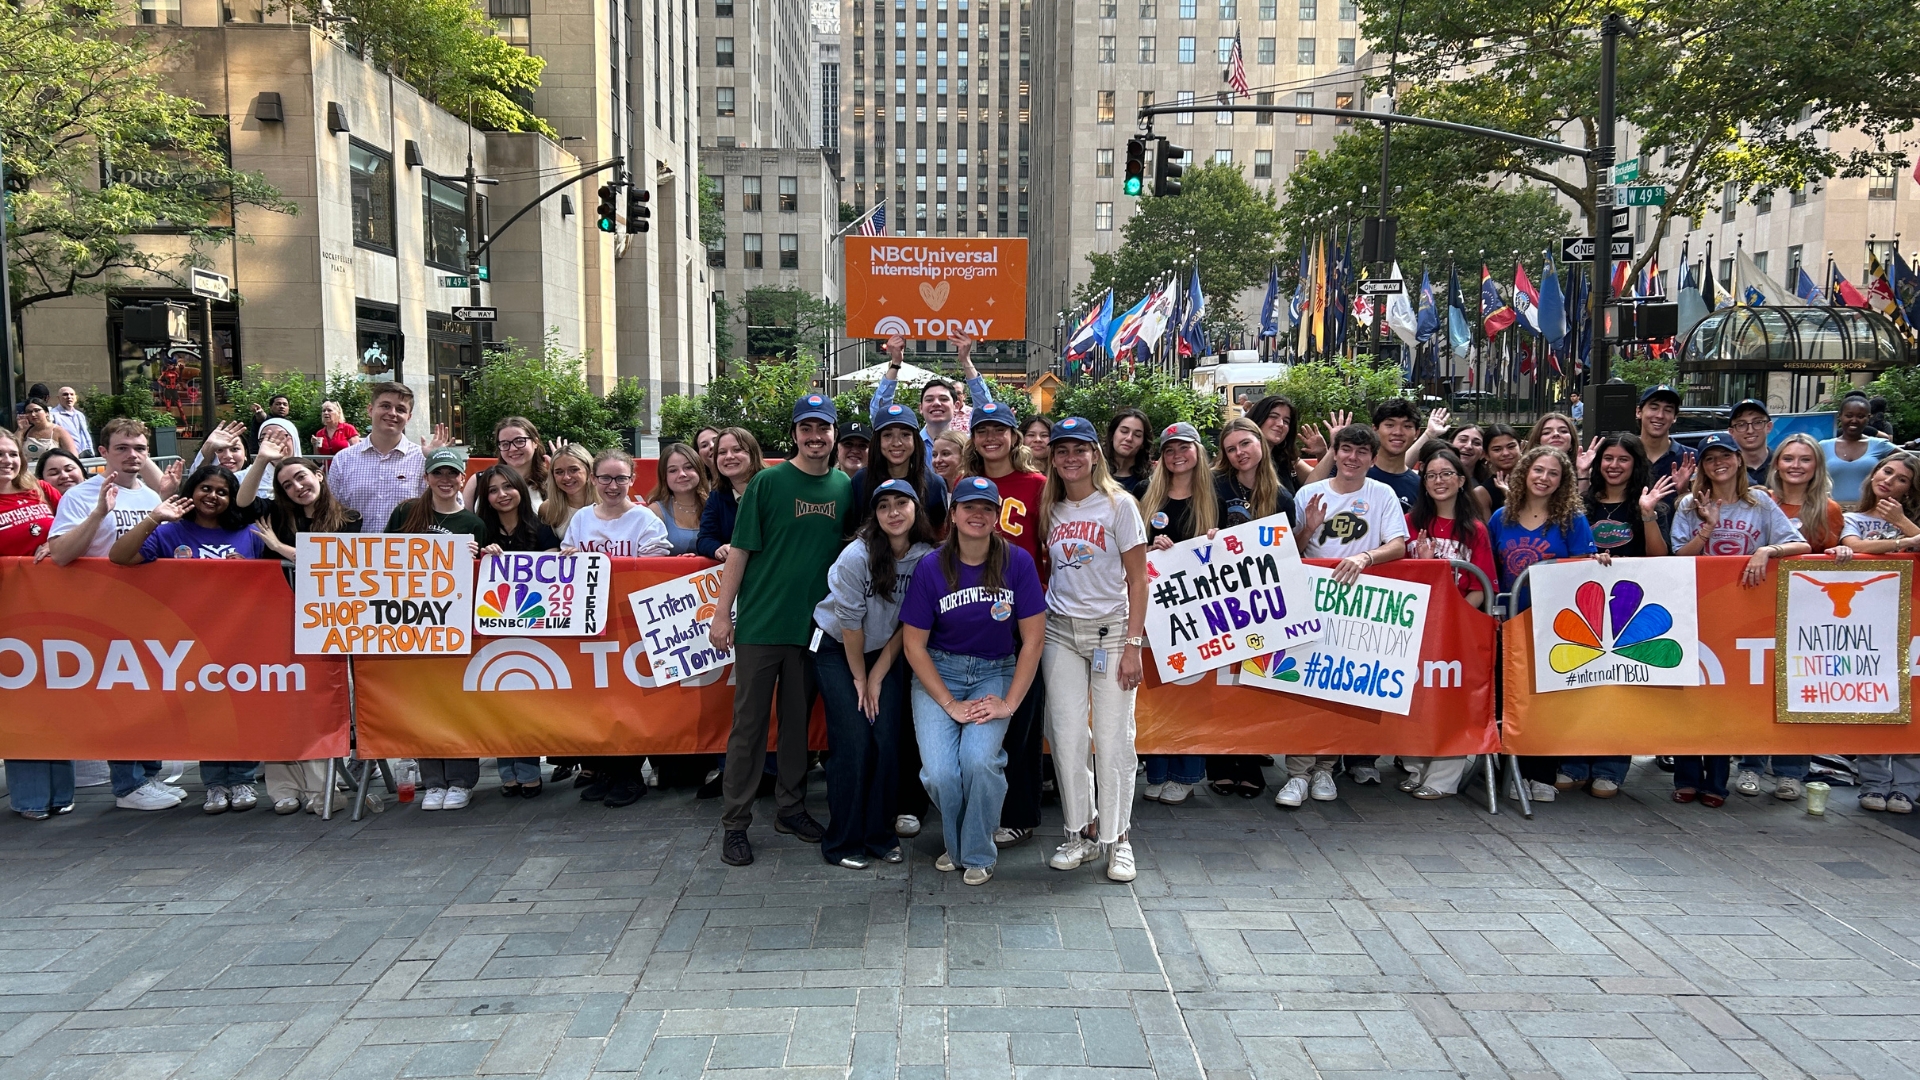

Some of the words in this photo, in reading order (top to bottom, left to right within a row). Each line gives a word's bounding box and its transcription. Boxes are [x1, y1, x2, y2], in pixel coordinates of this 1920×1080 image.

[1628, 189, 1637, 204] W
[1639, 188, 1653, 203] 49
[870, 245, 998, 264] NBCUniversal
[1573, 244, 1594, 255] ONE
[1611, 244, 1626, 254] AY
[331, 263, 346, 273] PLAZA
[871, 262, 941, 280] internship
[943, 266, 998, 281] program
[446, 277, 452, 287] W
[453, 277, 462, 287] 49
[458, 310, 472, 318] ONE
[477, 310, 492, 318] WAY
[913, 318, 994, 337] TODAY
[1166, 425, 1178, 436] N
[795, 498, 836, 520] MIAMI
[1258, 525, 1288, 547] UF
[1331, 515, 1356, 538] CU
[1857, 520, 1891, 536] SYRA
[309, 536, 455, 571] INTERN
[579, 539, 633, 557] McGill
[1061, 542, 1078, 562] V
[1223, 534, 1244, 555] BU
[488, 554, 579, 584] NBCU
[310, 570, 463, 600] TESTED,
[1152, 553, 1281, 609] #Intern
[548, 583, 575, 602] 20
[584, 556, 601, 634] INTERN
[1309, 576, 1418, 629] EBRATING
[302, 600, 368, 629] SHOP
[369, 599, 453, 625] TODAY
[549, 601, 573, 617] 25
[638, 593, 697, 625] Intern
[1170, 611, 1200, 647] At
[1201, 585, 1288, 637] NBCU
[479, 617, 525, 629] MSNBC
[545, 617, 571, 629] LIVE
[1284, 618, 1322, 640] NYU
[321, 624, 465, 653] APPROVED
[645, 618, 711, 656] Industr
[1324, 617, 1383, 655] INTERN
[1384, 627, 1413, 658] DAY
[1798, 624, 1879, 652] NATIONAL
[1303, 652, 1405, 699] #adsales
[1792, 655, 1851, 678] INTERN
[1856, 655, 1881, 677] DAY
[1800, 681, 1890, 704] #HOOKEM
